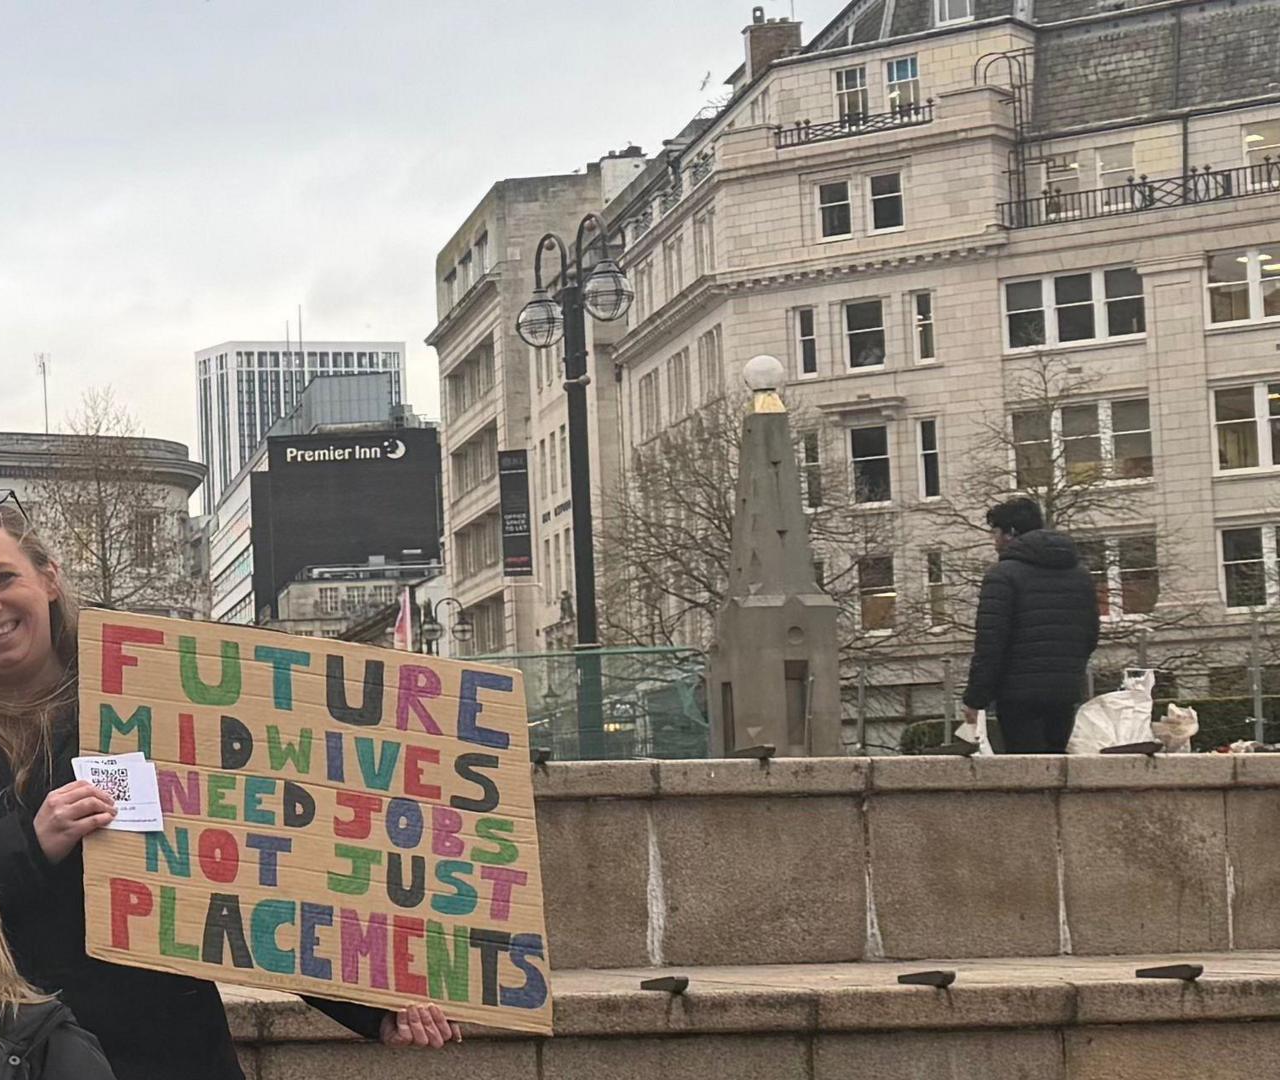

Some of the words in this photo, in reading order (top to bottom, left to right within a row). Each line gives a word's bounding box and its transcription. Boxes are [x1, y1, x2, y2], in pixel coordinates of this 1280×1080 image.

[286, 446, 352, 462] Premier
[355, 445, 381, 459] Inn
[101, 623, 513, 749] FUTURE
[99, 703, 500, 812] MIDWIVES
[157, 770, 316, 828] NEED
[333, 789, 520, 864] JOBS
[145, 827, 292, 887] NOT
[327, 843, 527, 921] JUST
[109, 877, 548, 1009] PLACEMENTS
